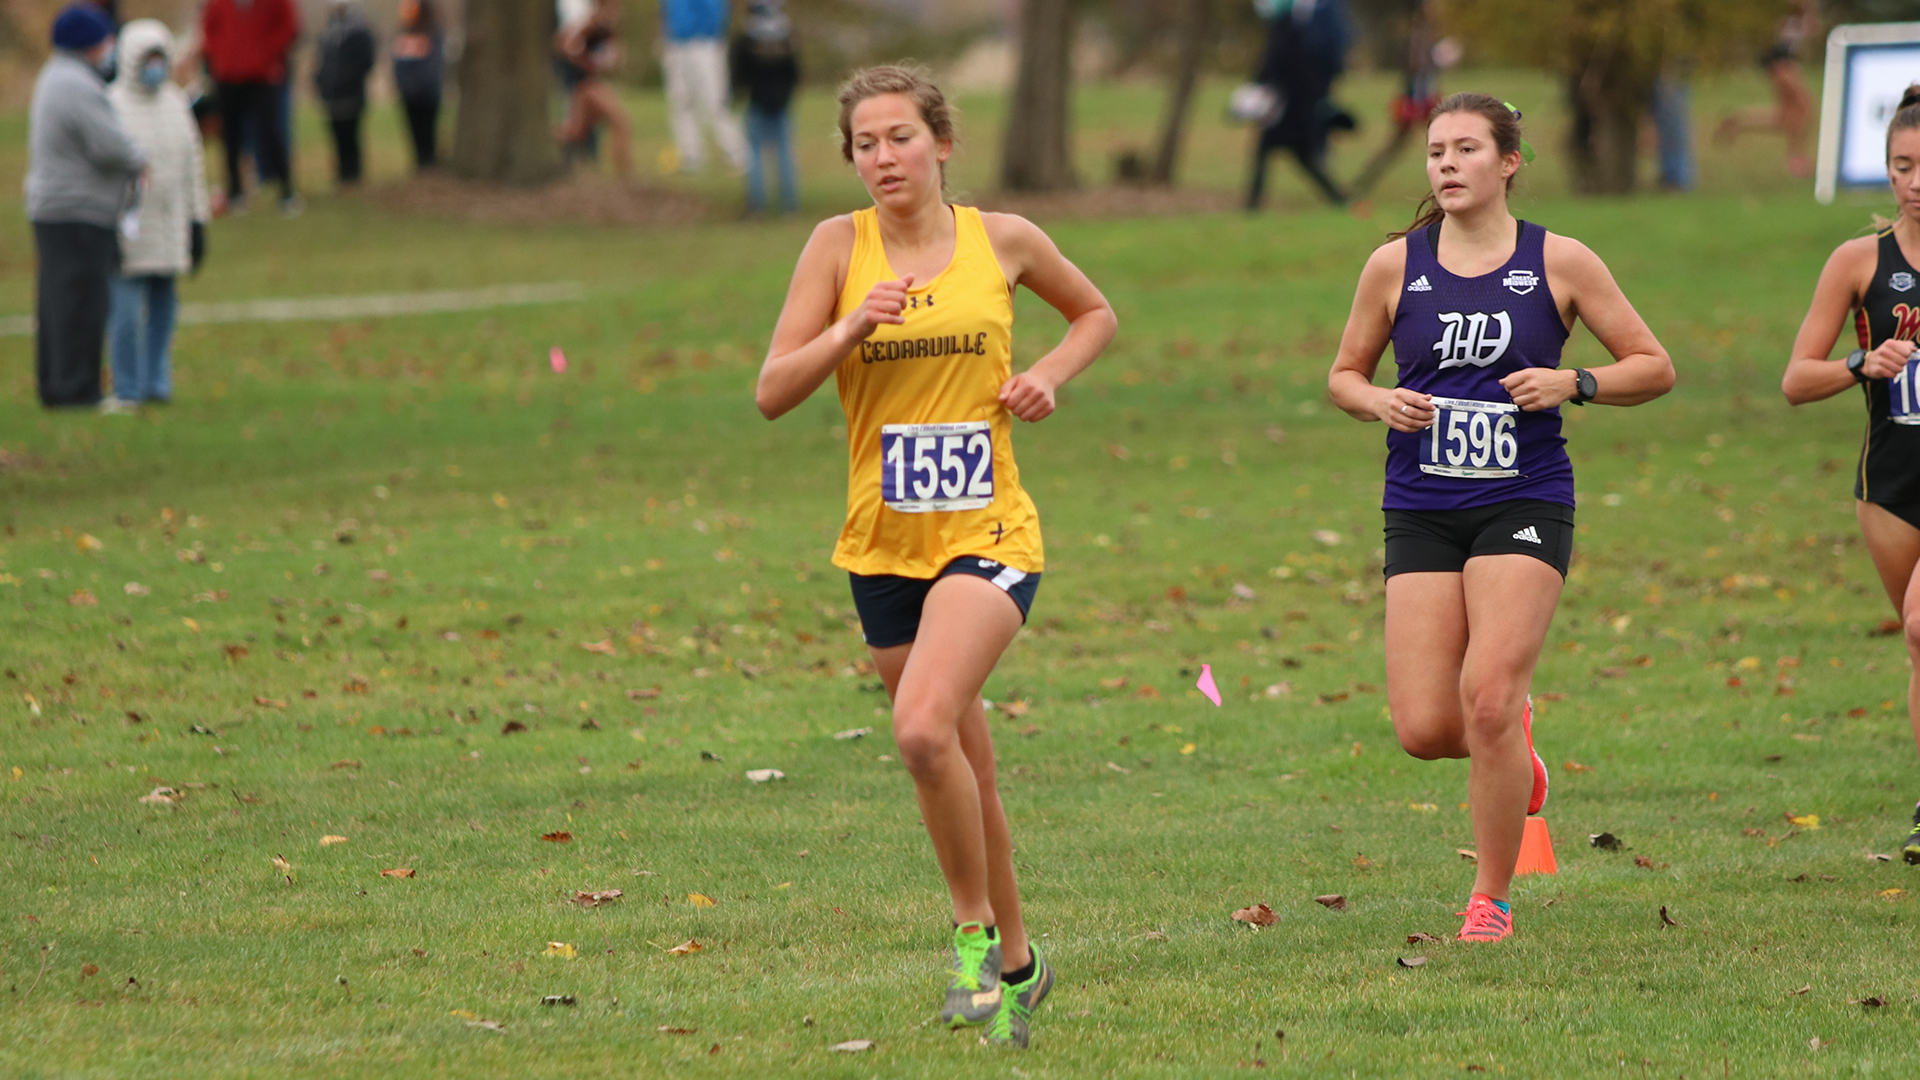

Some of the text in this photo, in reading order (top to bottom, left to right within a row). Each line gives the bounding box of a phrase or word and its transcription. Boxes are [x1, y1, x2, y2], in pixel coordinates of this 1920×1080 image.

[1407, 284, 1433, 292] adidas
[861, 331, 988, 365] CEDARVILLE
[1425, 407, 1518, 469] 1596
[887, 432, 993, 500] 1552
[1512, 533, 1542, 545] adidas
